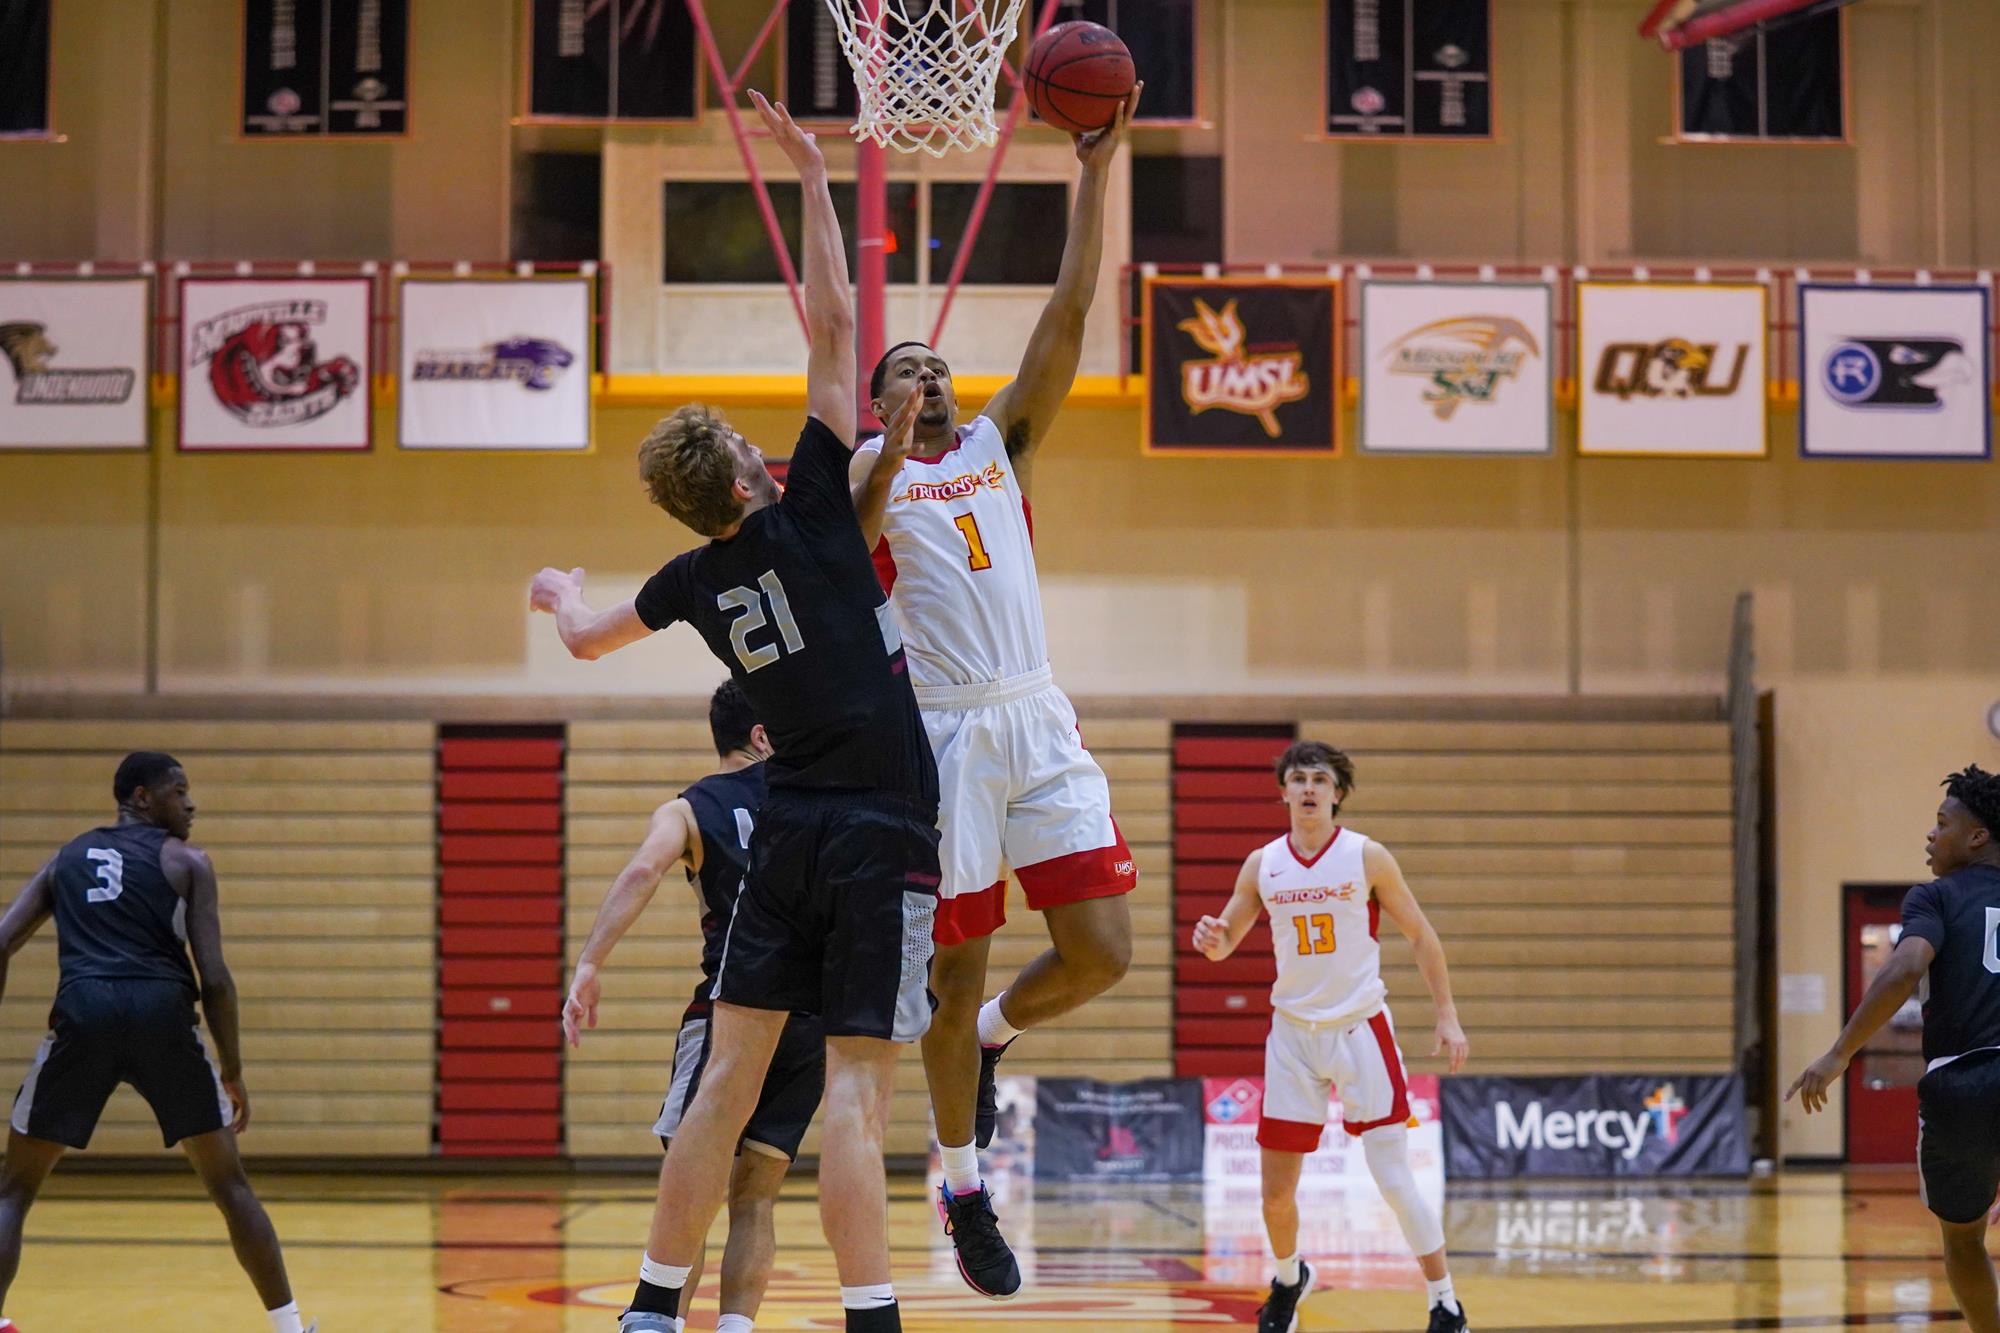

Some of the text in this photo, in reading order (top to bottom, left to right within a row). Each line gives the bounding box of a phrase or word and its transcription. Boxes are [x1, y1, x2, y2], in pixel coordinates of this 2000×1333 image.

[1185, 354, 1309, 408] UMSL
[908, 474, 978, 502] TRITONS
[953, 511, 993, 572] 1
[717, 568, 805, 674] 21
[86, 847, 123, 903] 3
[1273, 887, 1332, 905] TRITONS
[1291, 912, 1337, 956] 13
[1495, 1101, 1650, 1160] Mercy
